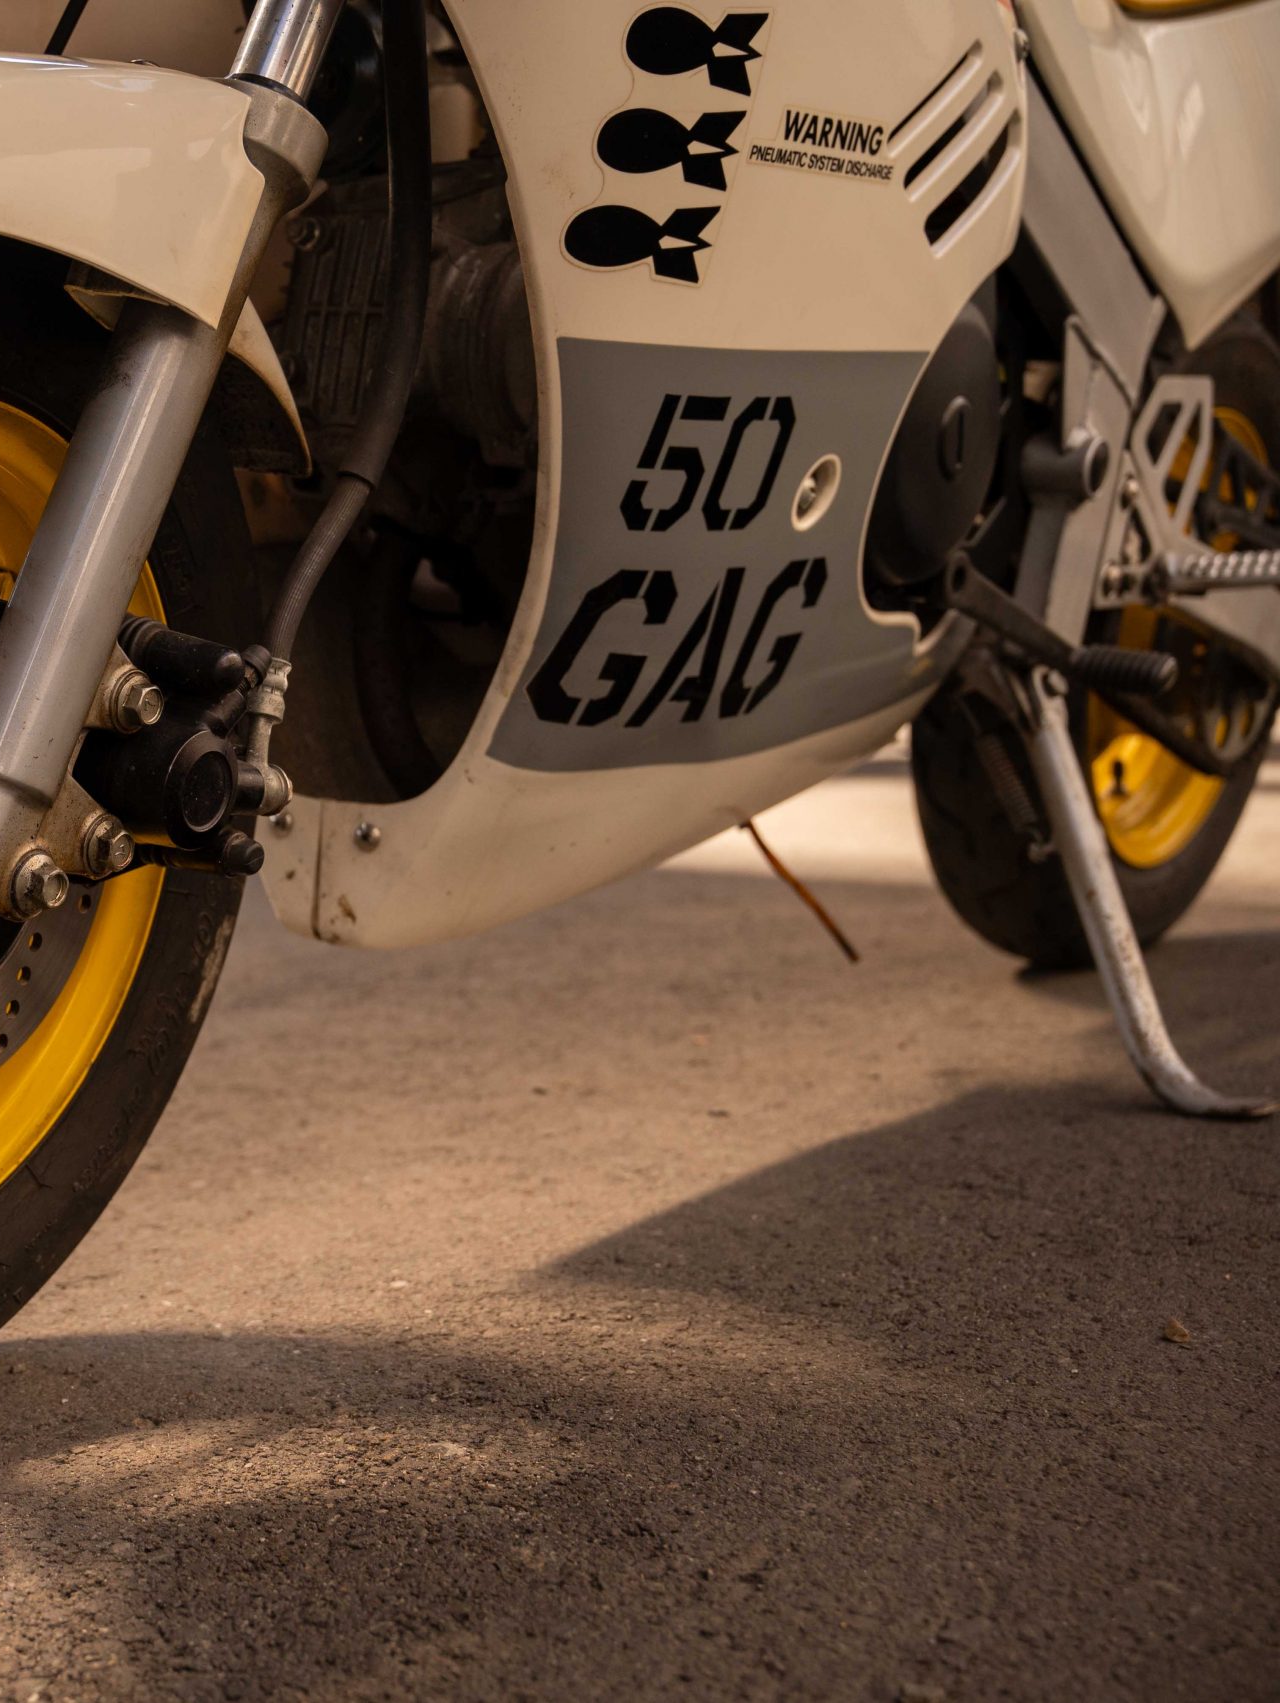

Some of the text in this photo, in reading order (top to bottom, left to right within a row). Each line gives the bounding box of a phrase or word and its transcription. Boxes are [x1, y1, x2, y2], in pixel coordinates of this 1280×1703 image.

[749, 144, 894, 180] PNEUMATIC SYSTEM DISCHARGE
[784, 110, 884, 156] WARNING
[620, 394, 797, 532] 50
[526, 557, 828, 728] GAG
